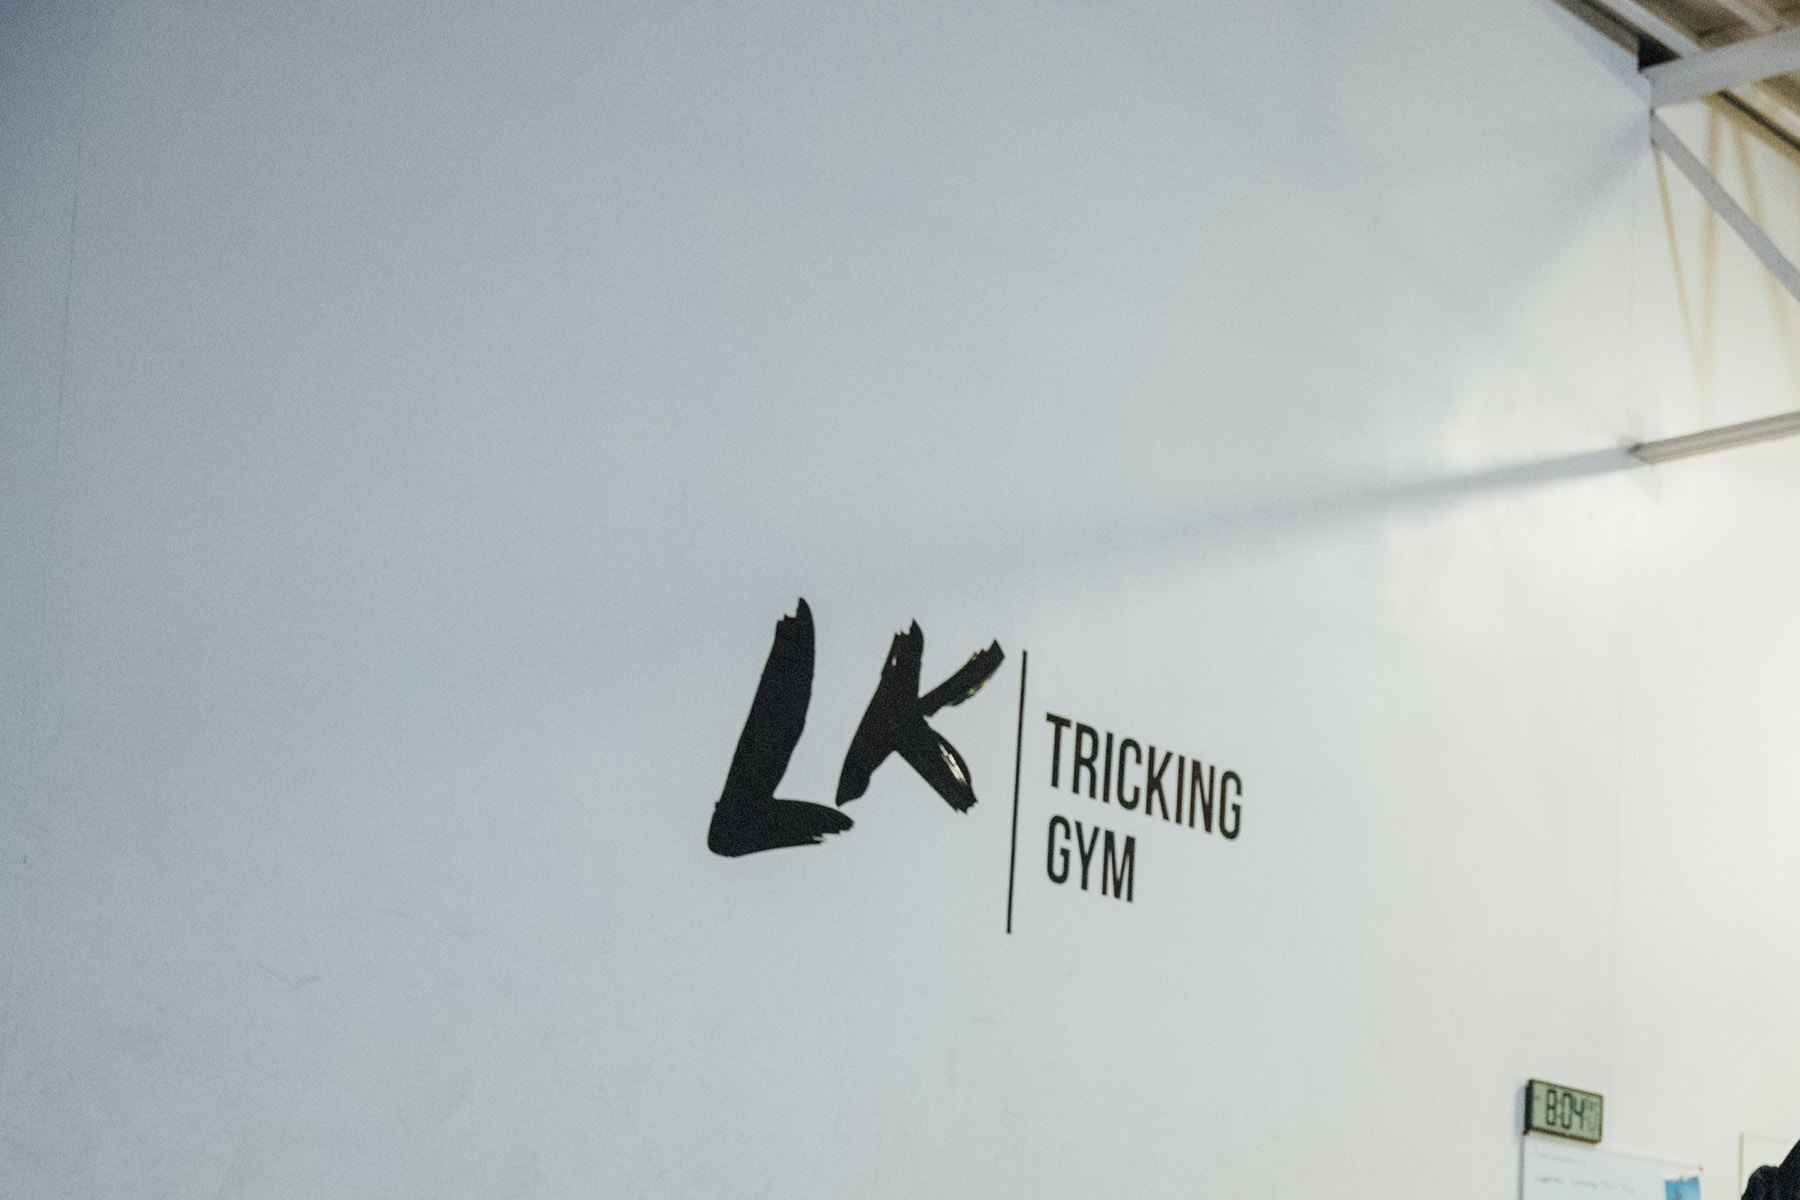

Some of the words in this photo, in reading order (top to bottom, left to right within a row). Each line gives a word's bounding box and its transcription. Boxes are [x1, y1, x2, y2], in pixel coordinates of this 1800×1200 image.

[708, 598, 1004, 857] LK
[1046, 713, 1241, 840] TRICKING
[1046, 815, 1135, 902] GYM
